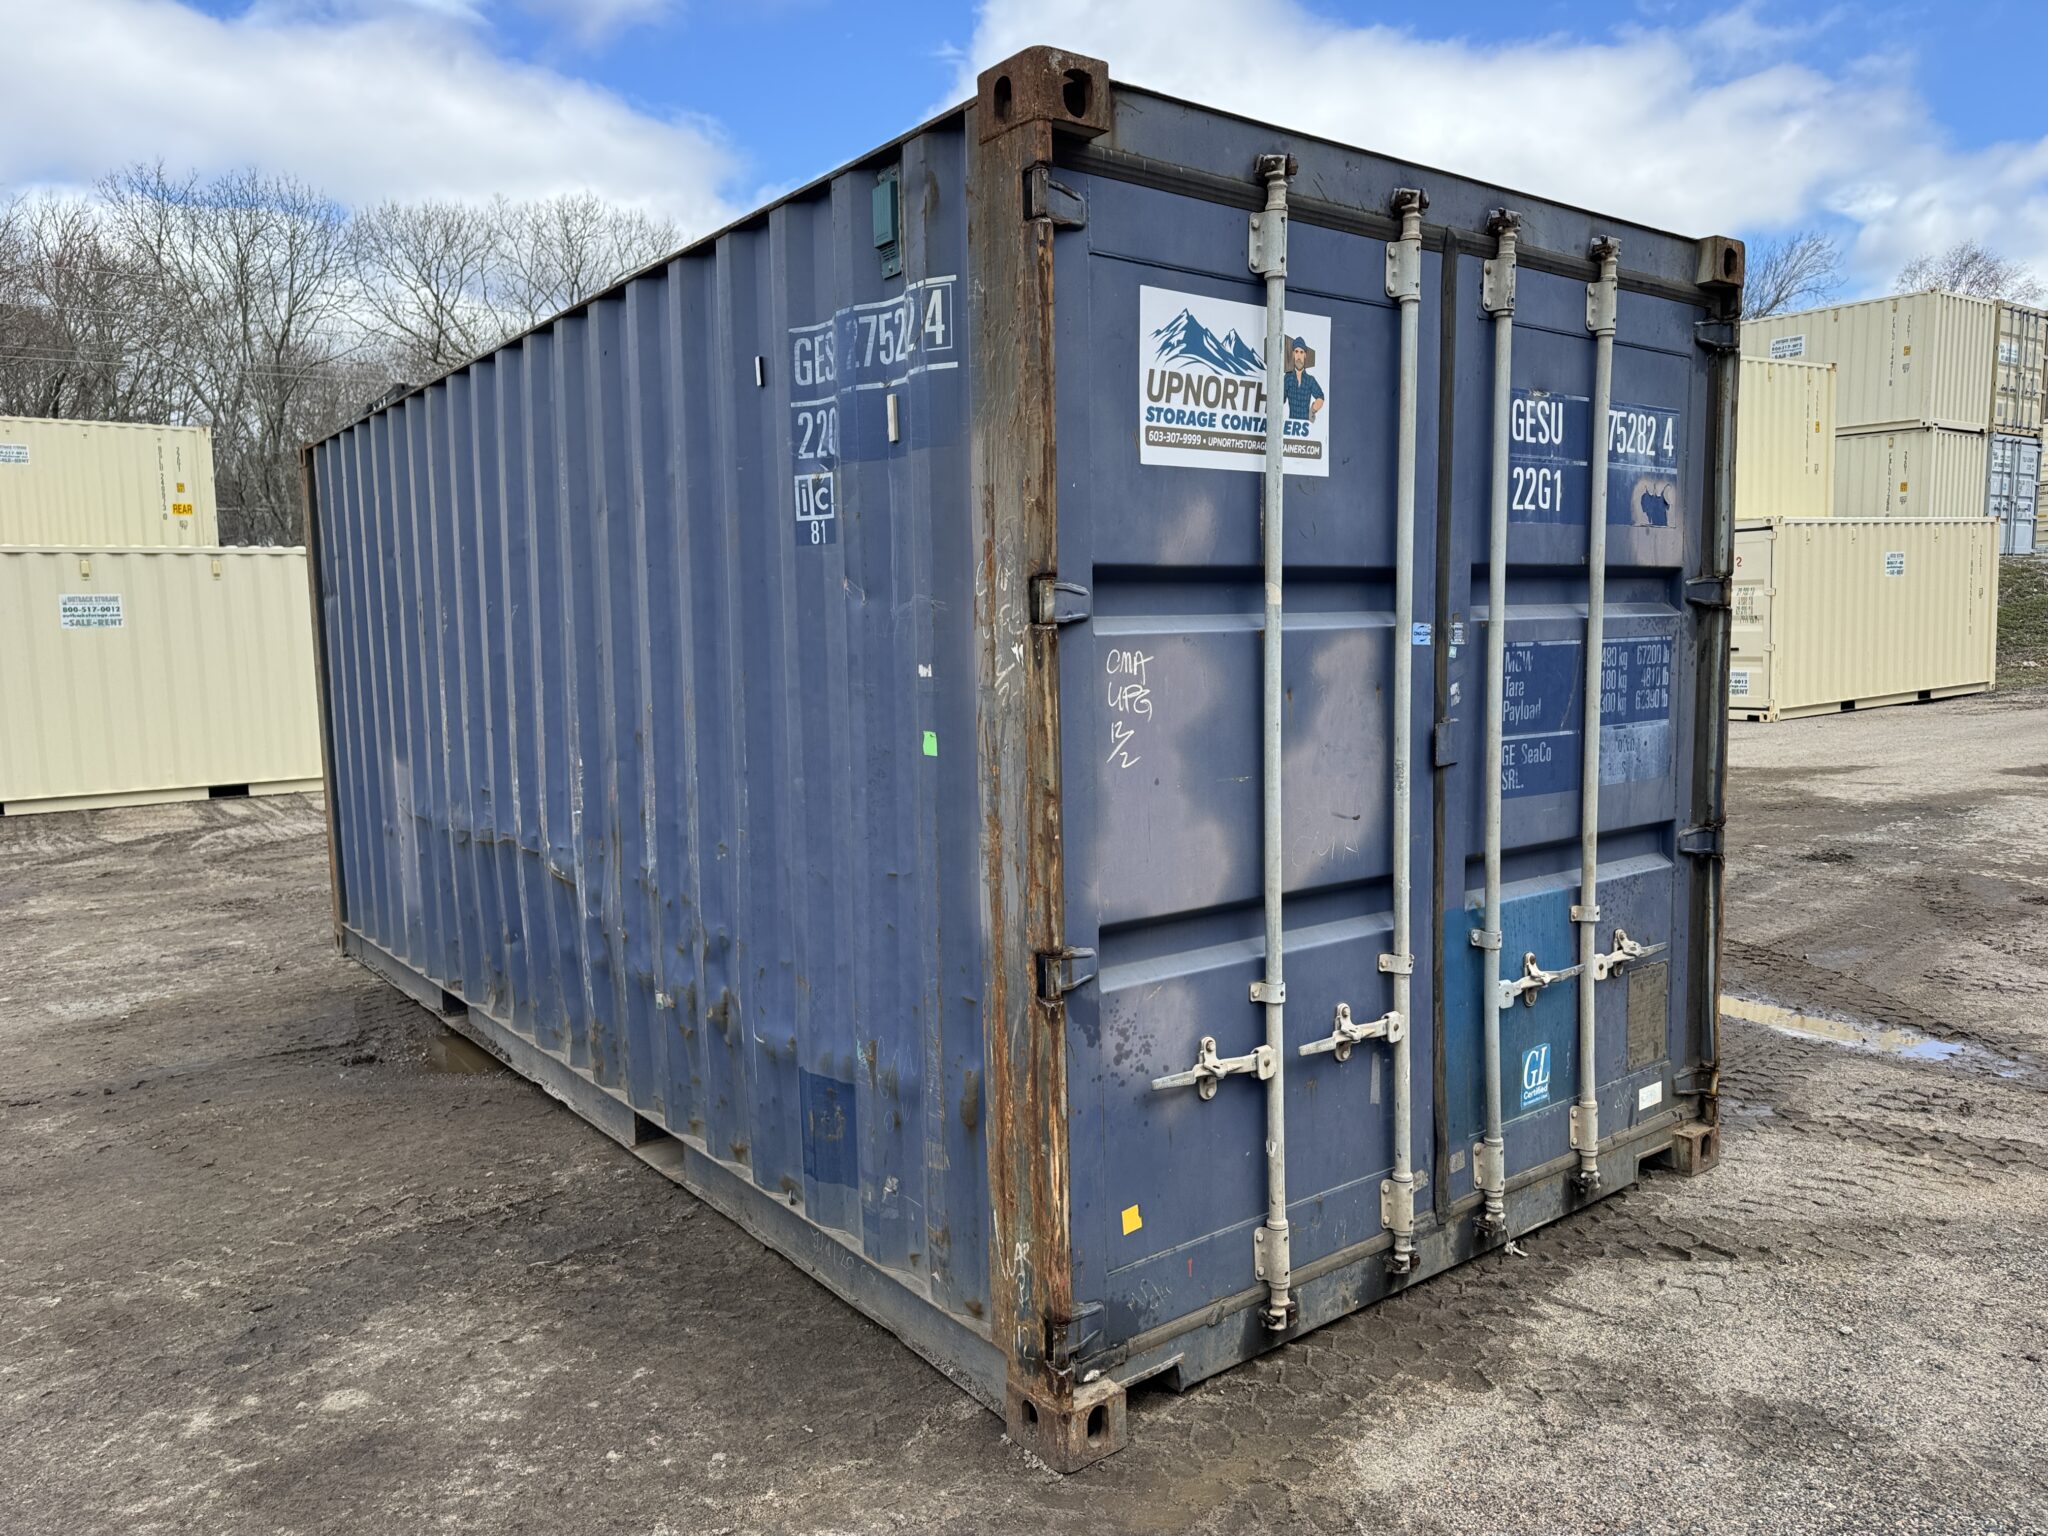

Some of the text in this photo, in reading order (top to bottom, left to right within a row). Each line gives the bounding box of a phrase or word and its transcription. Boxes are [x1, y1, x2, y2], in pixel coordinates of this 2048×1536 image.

[925, 289, 946, 345] 4
[1146, 368, 1267, 414] UPNORTH
[1145, 405, 1310, 437] STORAGE CONTAERS
[1512, 399, 1674, 457] GESU 75282 4
[1148, 430, 1202, 446] 603-307-9999
[1512, 467, 1562, 511] 22G1
[172, 503, 192, 514] REAR
[811, 520, 826, 545] 81
[1106, 649, 1154, 685] CMA
[1619, 646, 1628, 670] kg
[1663, 644, 1670, 663] lb
[1504, 676, 1525, 698] Tare
[1601, 669, 1616, 690] 180
[1618, 669, 1627, 693] kg
[1662, 666, 1669, 686] lb
[1502, 698, 1541, 726] Payload
[1617, 692, 1627, 716] kg
[1661, 688, 1668, 708] lb
[1502, 741, 1552, 766] GE SeaCo
[1523, 1046, 1549, 1089] GL
[1523, 1083, 1548, 1100] Certified
